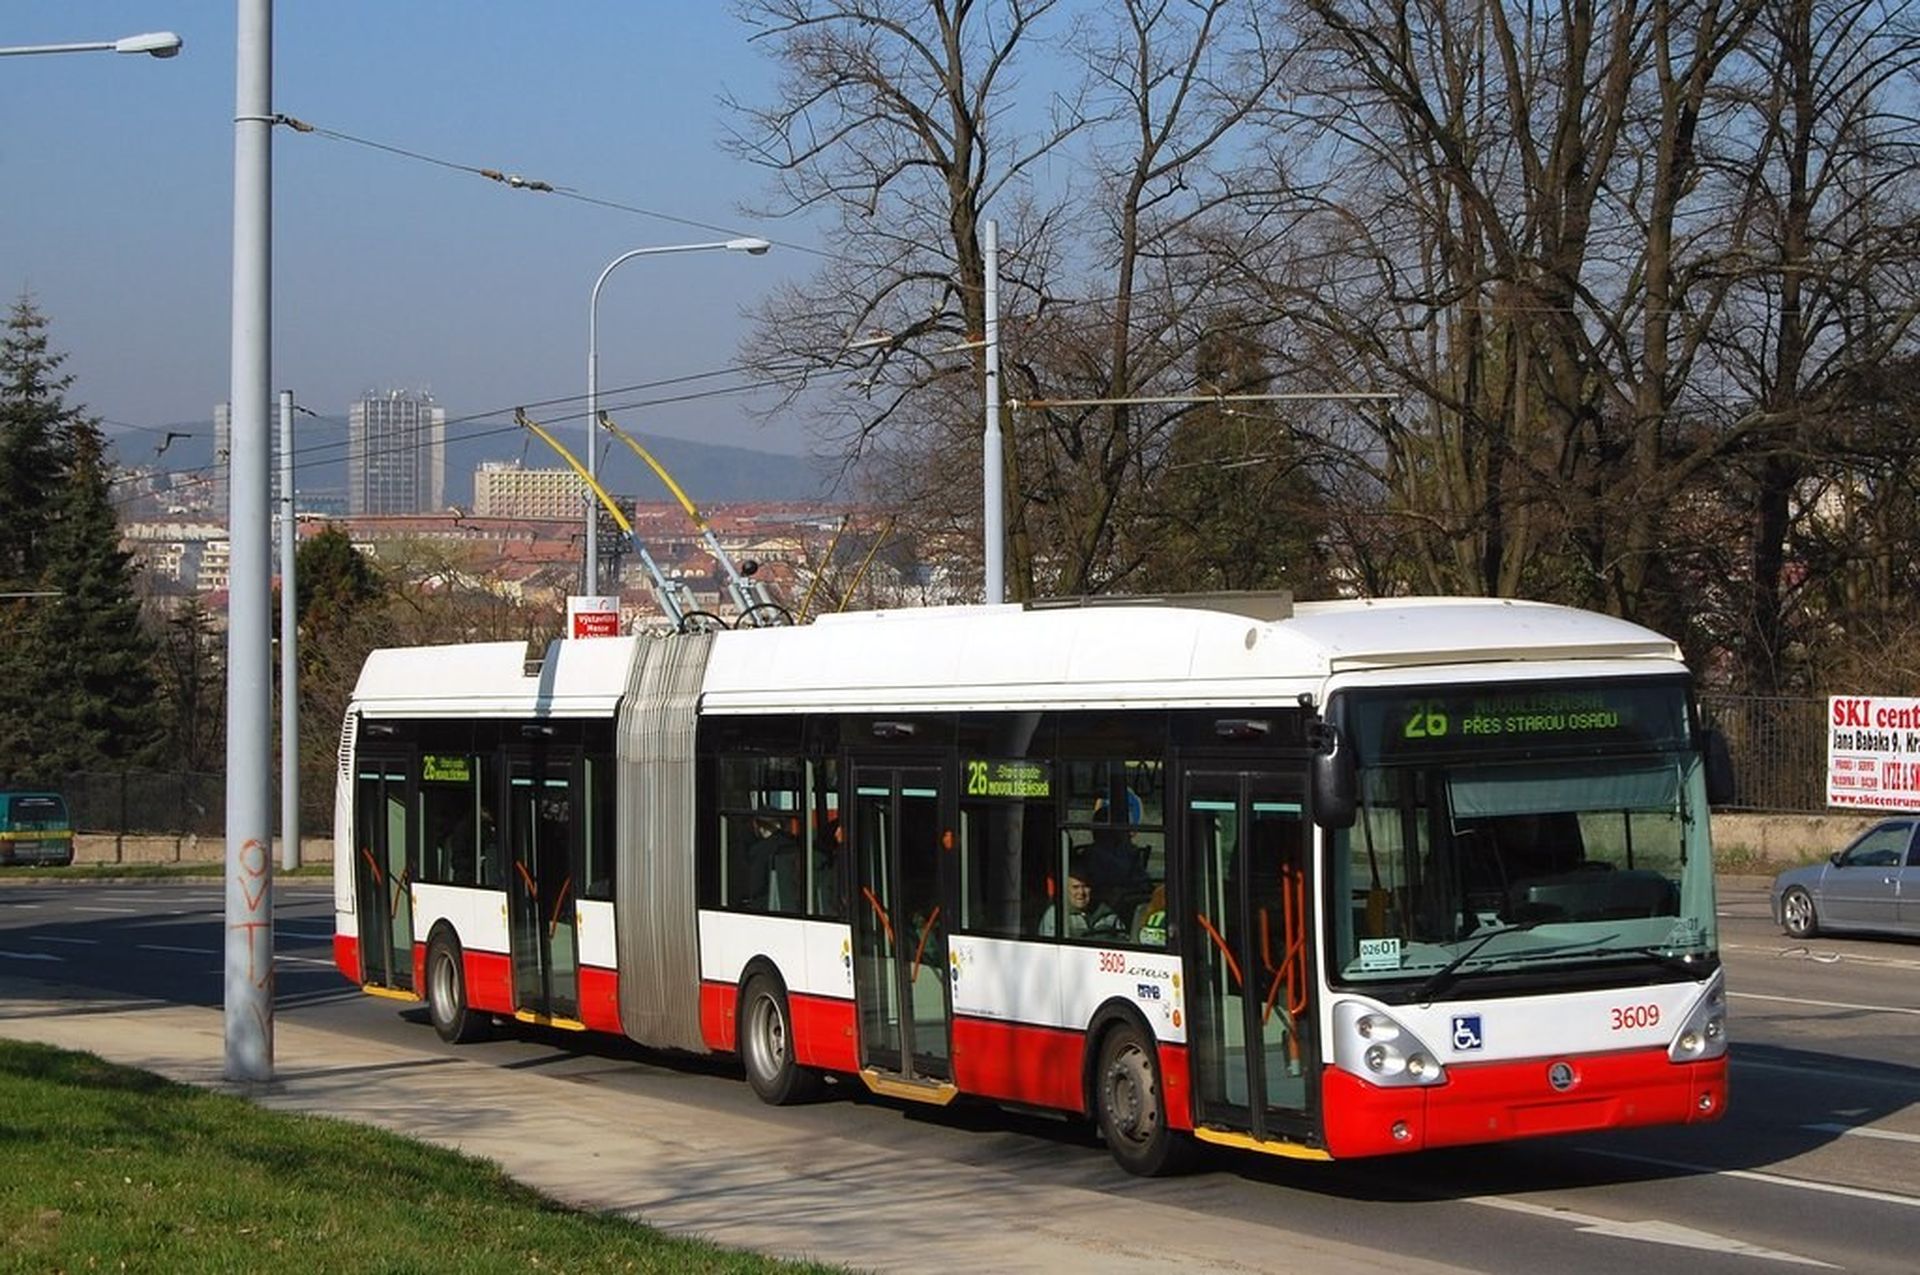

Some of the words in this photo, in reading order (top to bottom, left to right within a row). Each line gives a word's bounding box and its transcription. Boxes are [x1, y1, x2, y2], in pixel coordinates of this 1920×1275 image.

[1405, 701, 1447, 738] 26
[1505, 715, 1565, 733] STAROU
[1568, 712, 1618, 730] OSADU
[1833, 699, 1871, 727] SKI
[968, 761, 988, 795] 26
[1099, 951, 1126, 974] 3609
[1611, 1004, 1661, 1030] 3609
